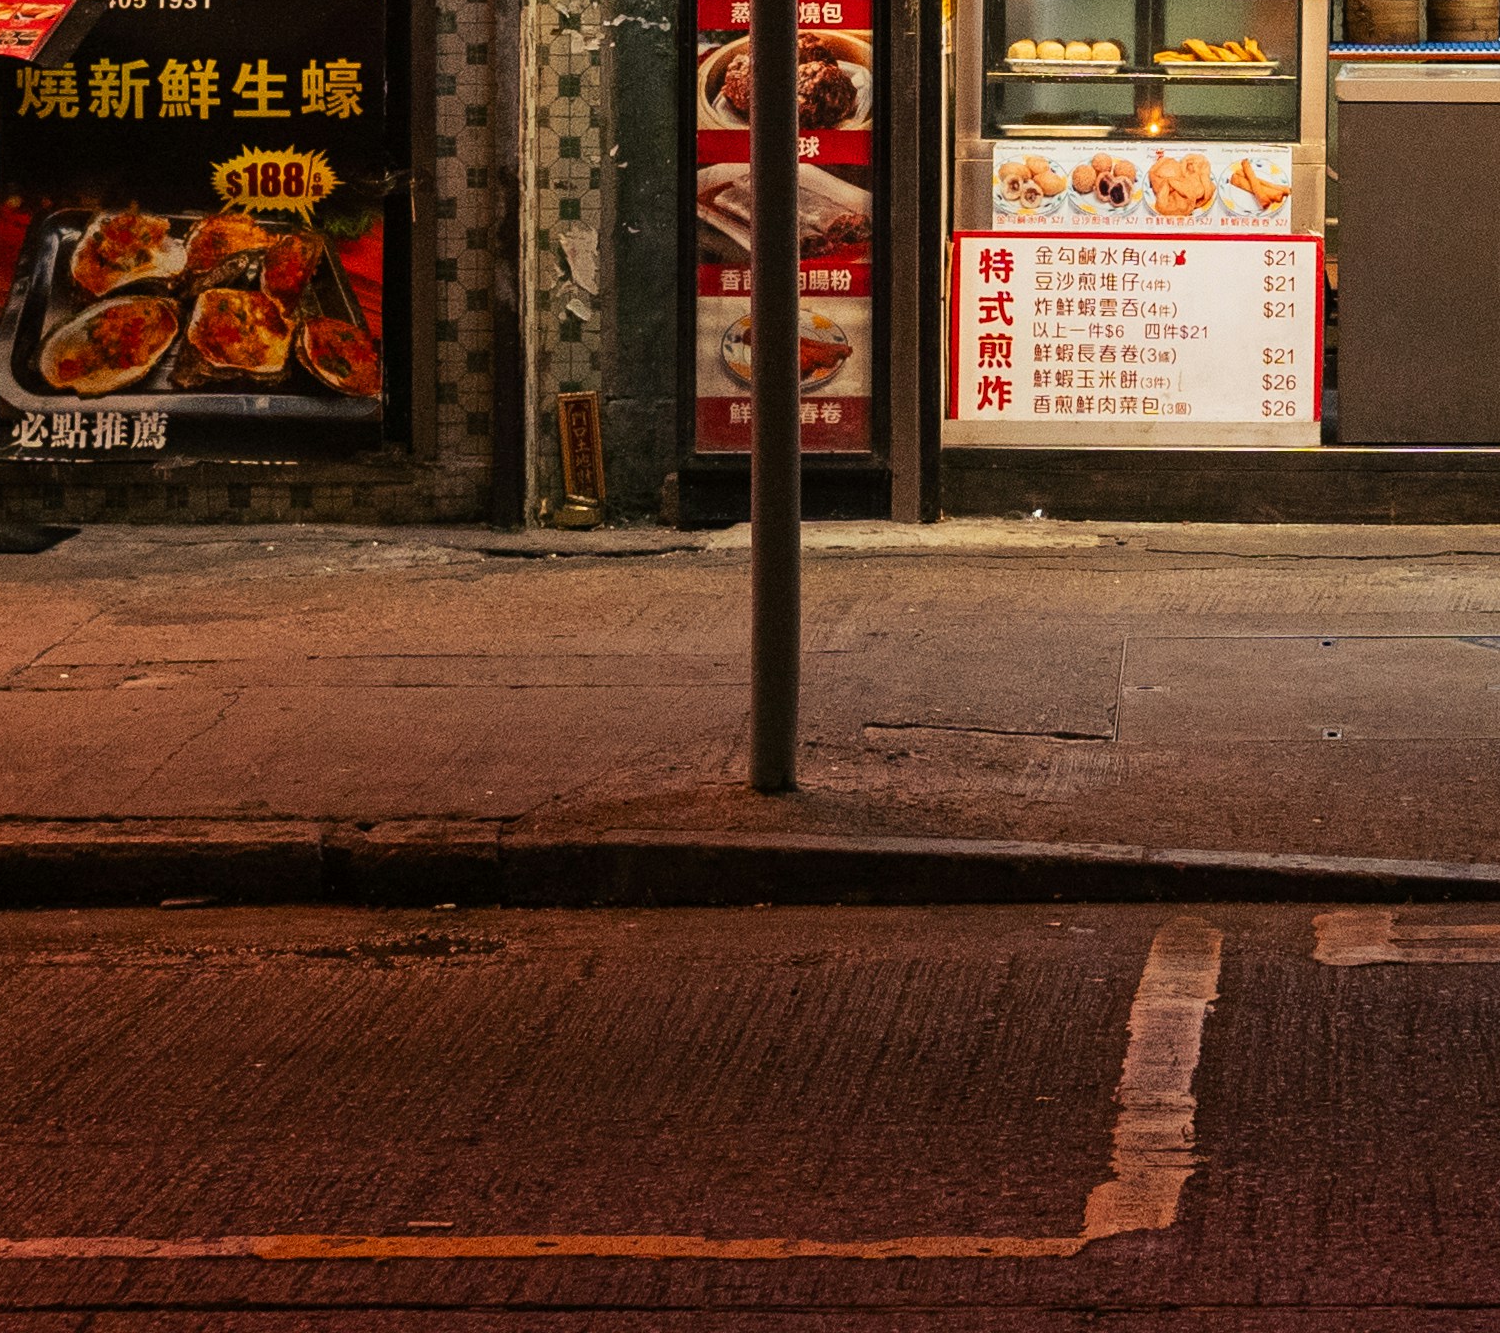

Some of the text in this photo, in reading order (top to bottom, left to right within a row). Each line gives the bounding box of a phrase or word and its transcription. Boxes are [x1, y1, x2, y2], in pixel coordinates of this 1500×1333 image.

[730, 1, 844, 25] 蒸燒包
[16, 58, 364, 119] 燒新鮮生蠔
[1263, 250, 1297, 267] $21
[1263, 275, 1296, 292] $21
[1263, 301, 1296, 318] $21
[977, 248, 1014, 412] 特式煎炸
[1032, 323, 1210, 340] 以上一件$6 四件$21
[1262, 348, 1296, 365] $21
[1262, 374, 1297, 391] $26
[1262, 400, 1297, 417] $26
[10, 411, 170, 451] 必點推薦
